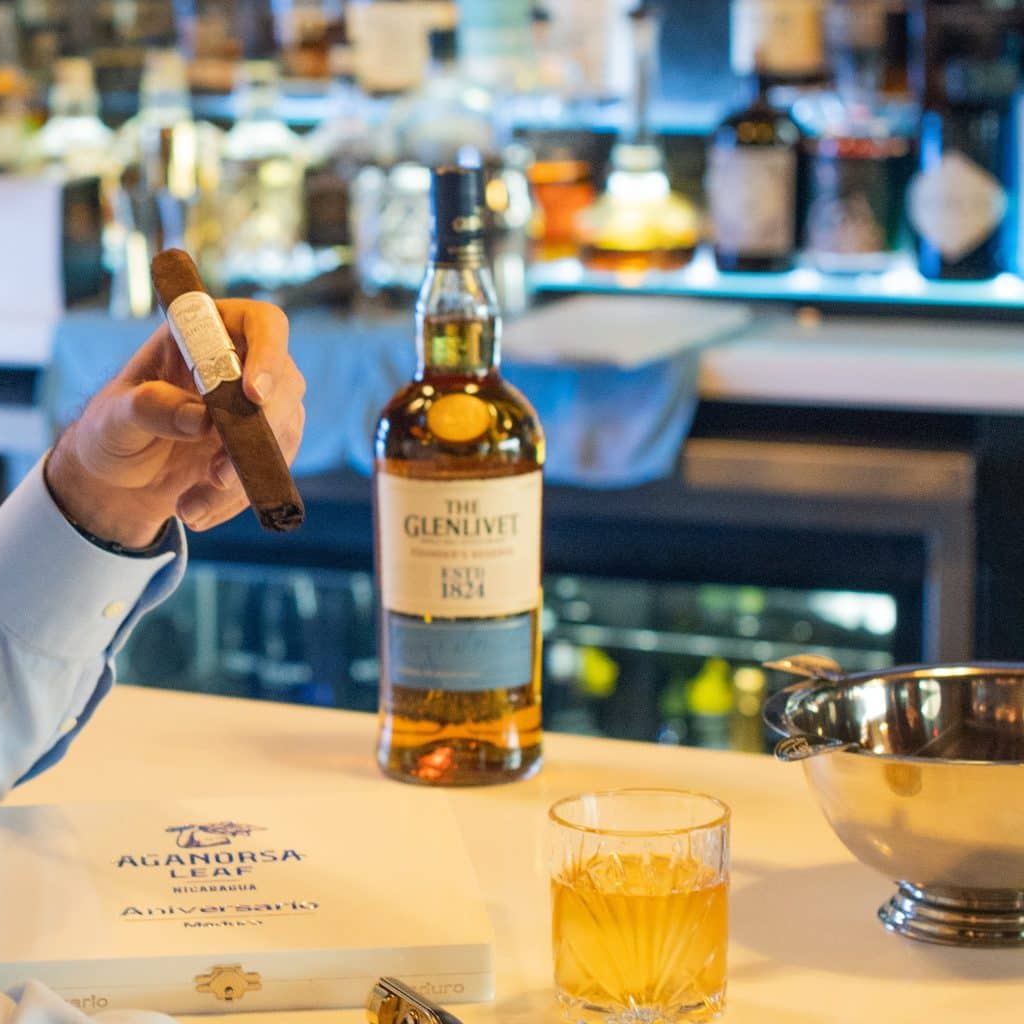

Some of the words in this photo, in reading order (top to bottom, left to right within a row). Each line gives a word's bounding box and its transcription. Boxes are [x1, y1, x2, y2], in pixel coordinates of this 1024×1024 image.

[445, 498, 480, 514] THE
[404, 514, 519, 537] GLENLIVET
[441, 581, 486, 599] 1824
[115, 849, 304, 868] AGANORSA
[169, 865, 253, 878] LEAF
[172, 883, 257, 894] NICARAGUA
[121, 900, 320, 916] Aniversario
